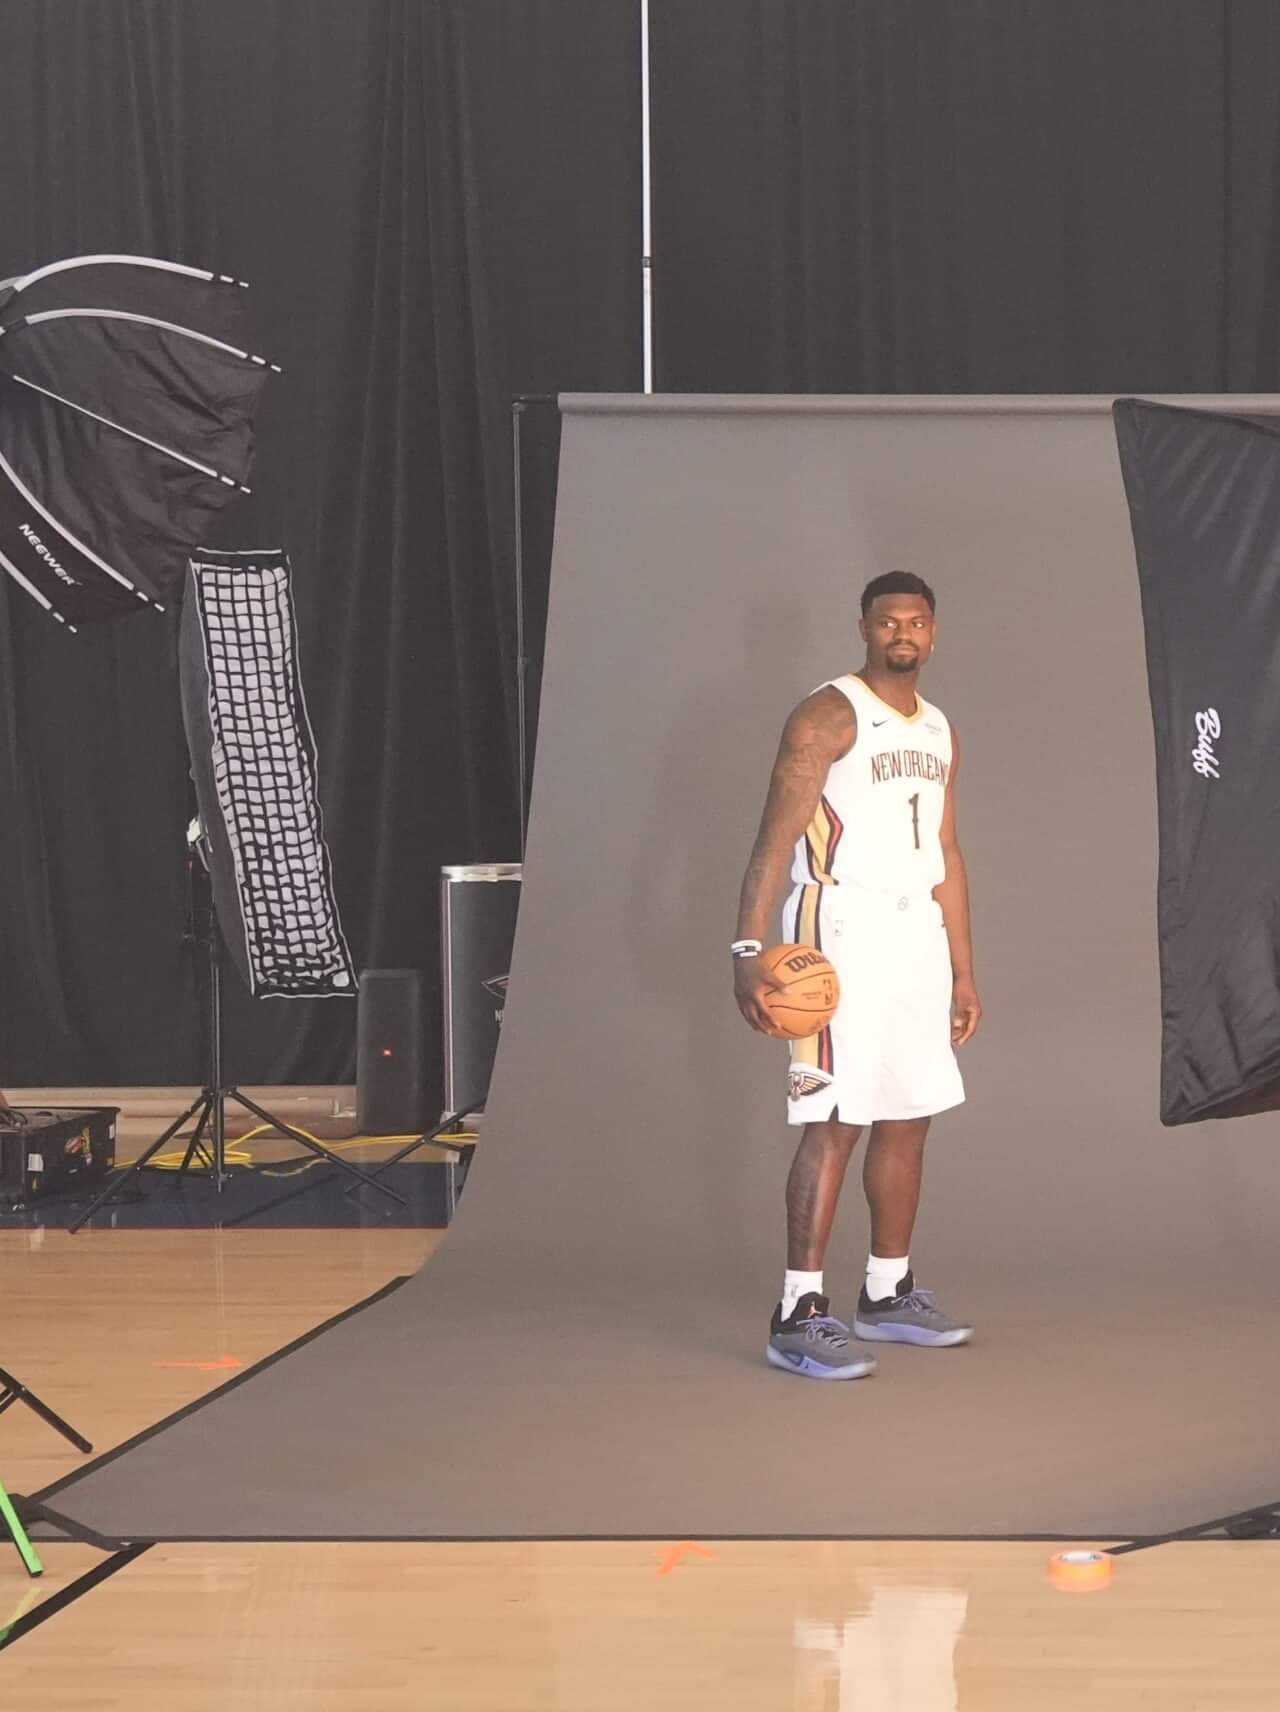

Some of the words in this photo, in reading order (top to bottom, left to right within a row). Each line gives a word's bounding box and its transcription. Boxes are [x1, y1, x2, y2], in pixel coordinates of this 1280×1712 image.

[19, 524, 75, 585] NEEWER
[870, 749, 902, 785] NEW
[1192, 708, 1221, 778] Buff
[908, 793, 920, 850] 1
